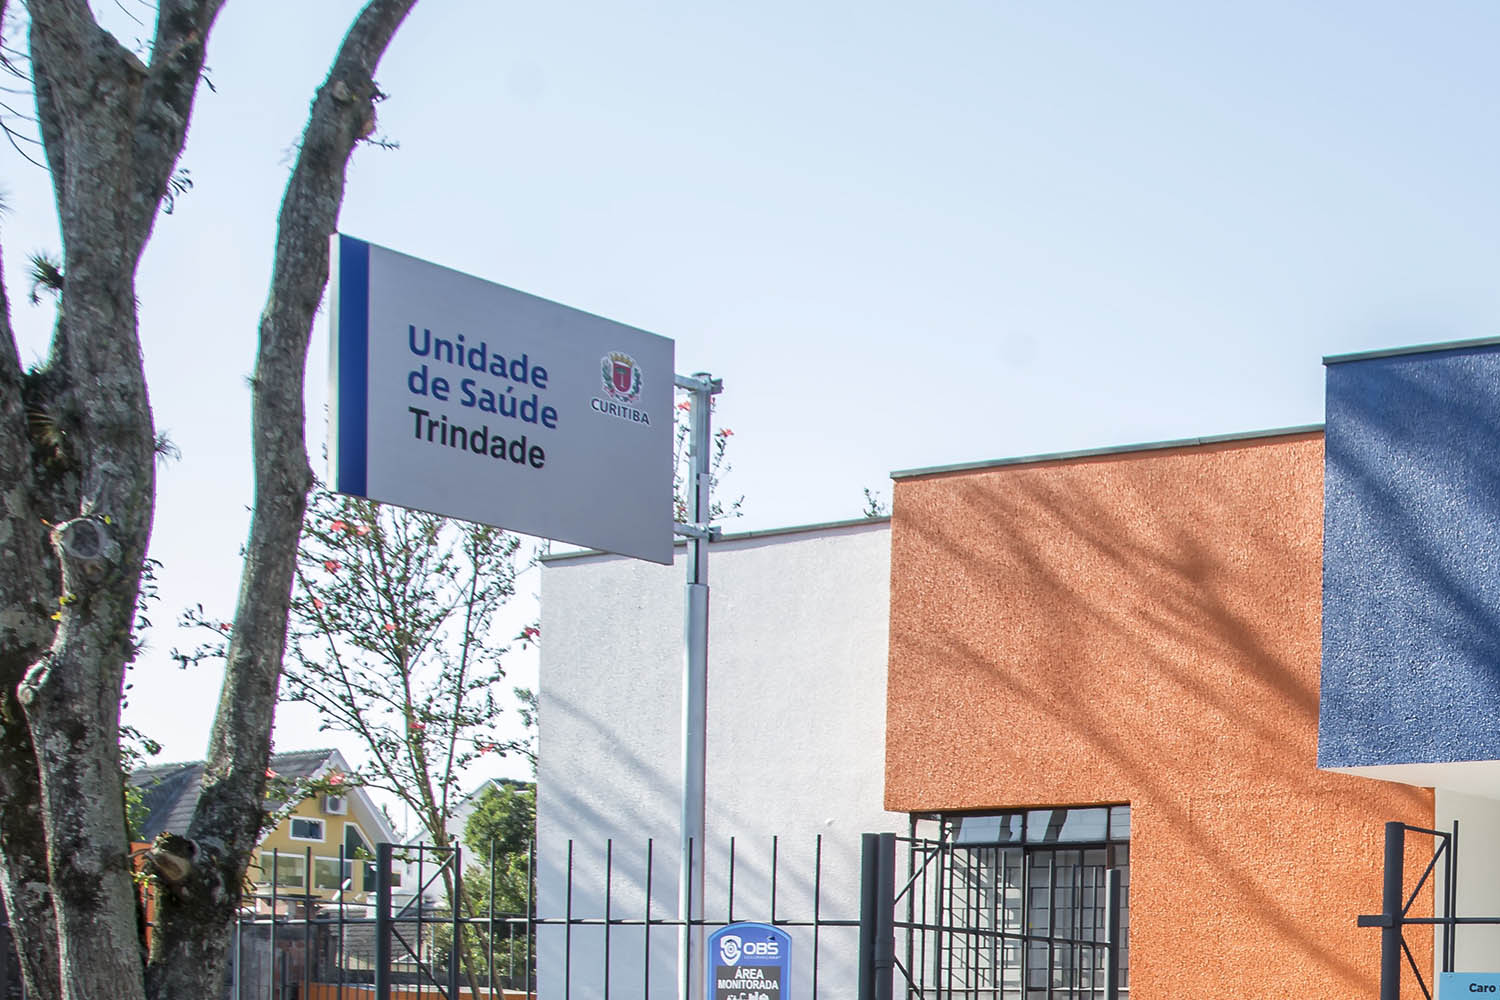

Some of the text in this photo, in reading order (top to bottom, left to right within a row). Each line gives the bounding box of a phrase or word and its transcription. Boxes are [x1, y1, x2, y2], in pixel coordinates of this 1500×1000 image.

[408, 324, 548, 390] Unidade
[407, 364, 558, 430] de Saúde
[591, 398, 650, 425] CURITIBA
[408, 406, 546, 469] Trindade
[743, 942, 779, 955] OBS
[735, 966, 764, 979] ÁREA
[718, 979, 779, 990] MONITORADA
[1469, 983, 1496, 993] Caro
